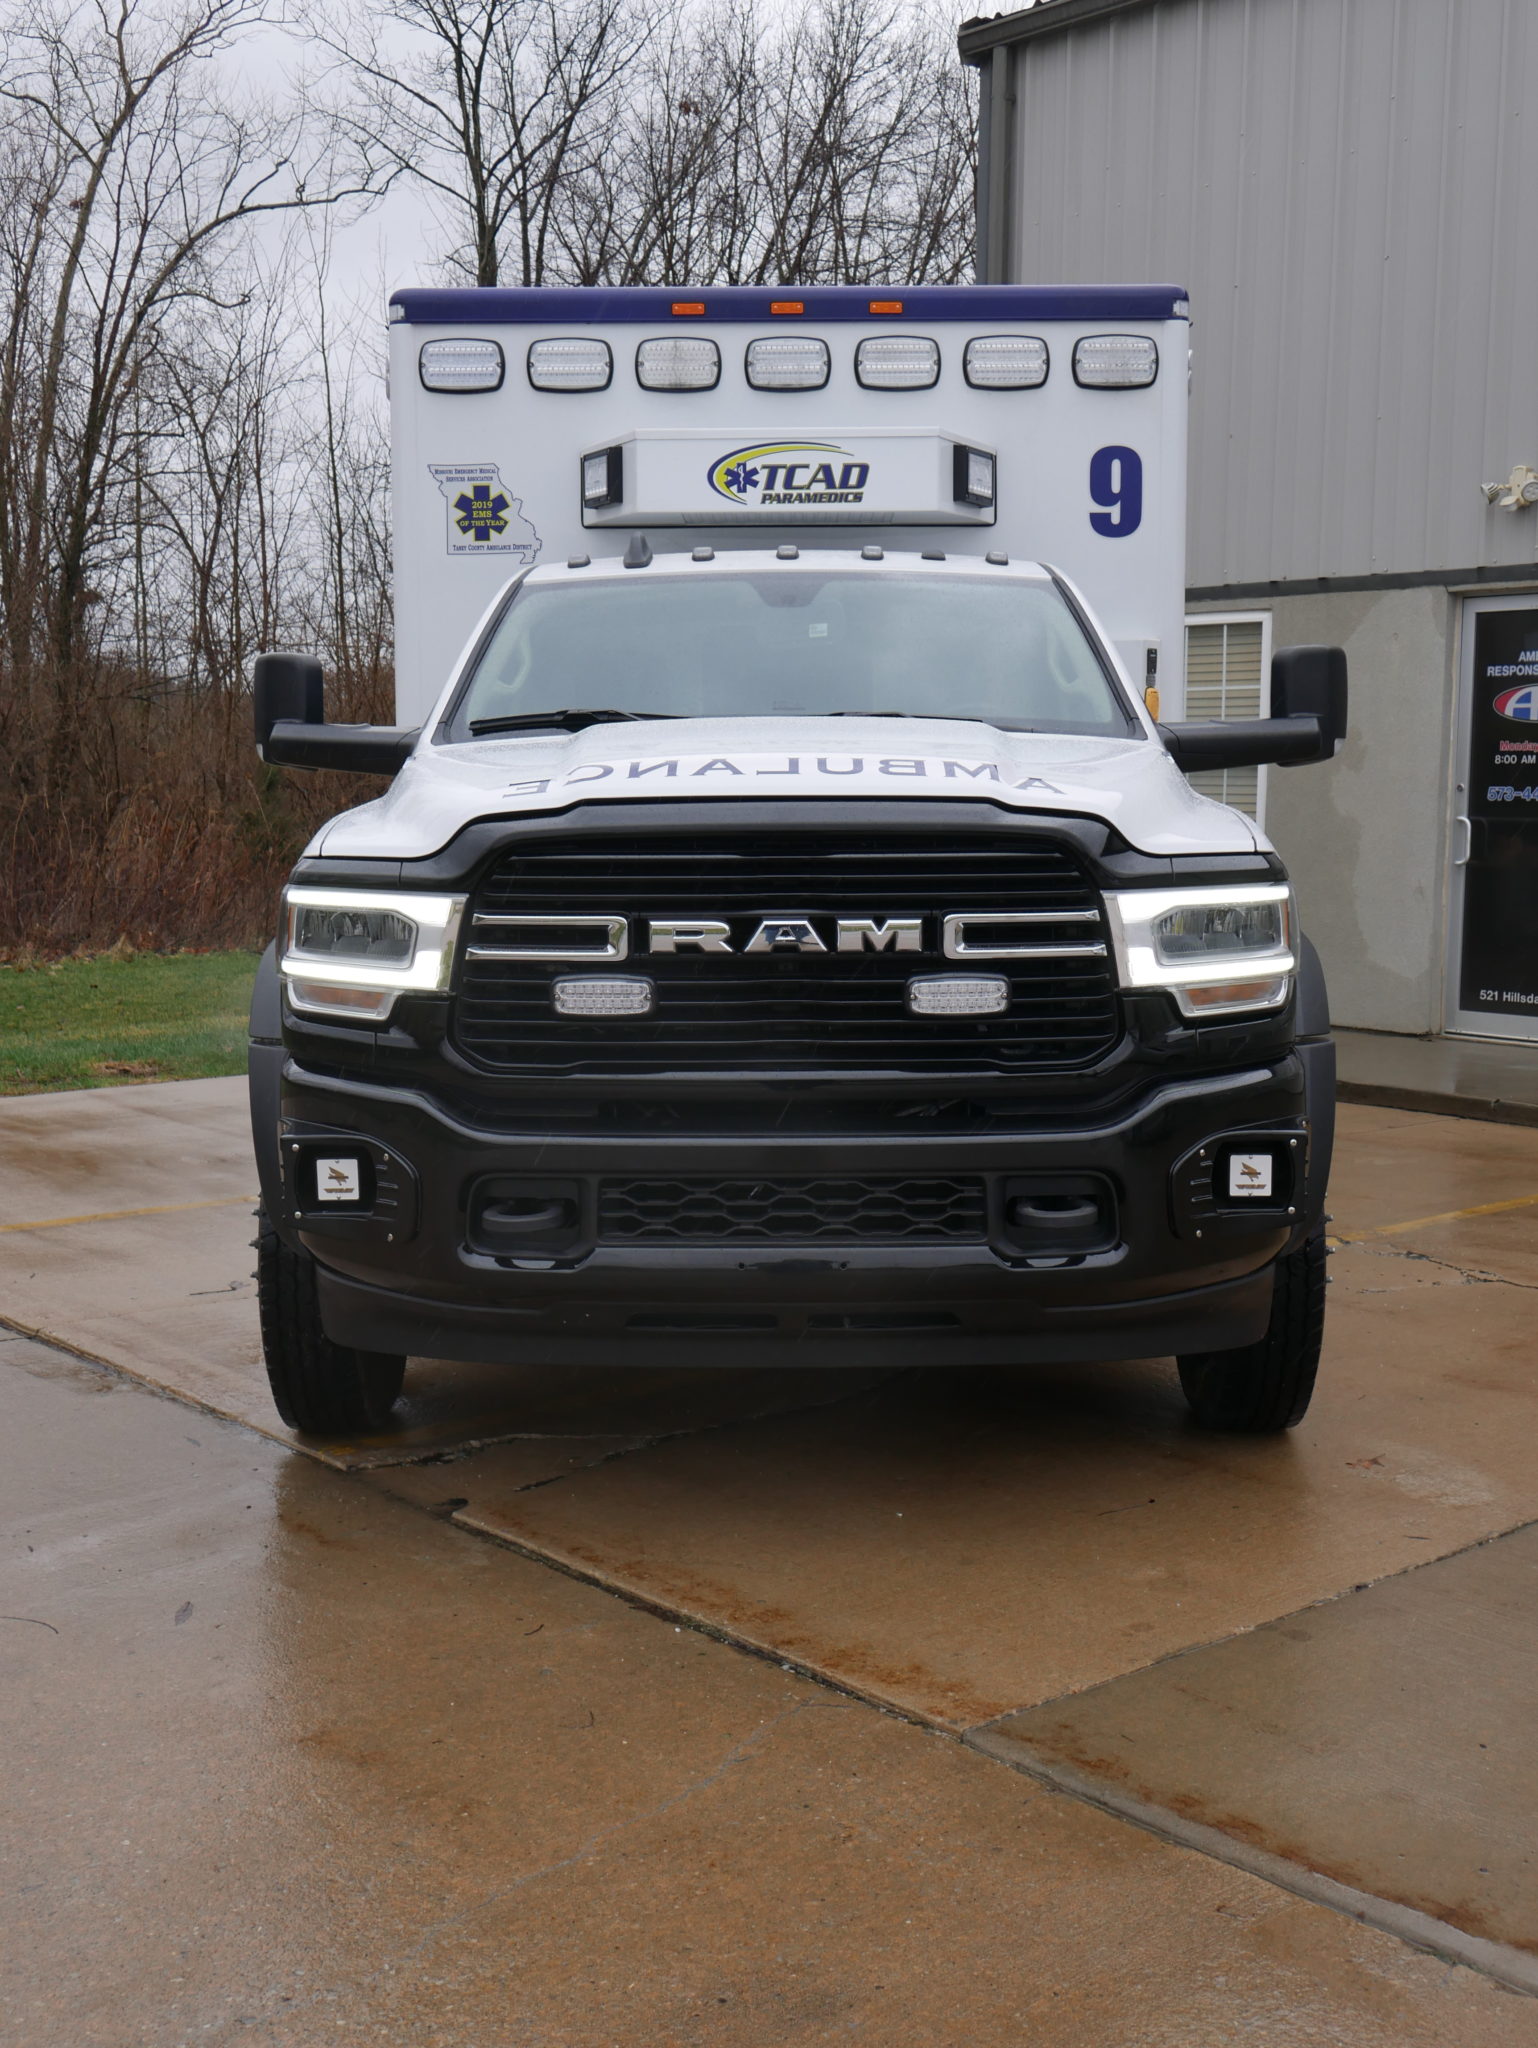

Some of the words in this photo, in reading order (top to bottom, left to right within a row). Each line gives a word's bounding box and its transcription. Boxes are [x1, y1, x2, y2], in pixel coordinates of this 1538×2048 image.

[760, 462, 870, 491] TCAD
[1089, 445, 1143, 538] 9
[760, 492, 864, 505] PARAMEDICS
[472, 501, 493, 509] 2019
[473, 510, 492, 518] EMS
[1494, 754, 1517, 764] 8:00
[1521, 754, 1536, 764] AM
[649, 919, 922, 952] RAM
[1479, 989, 1498, 1001] 521
